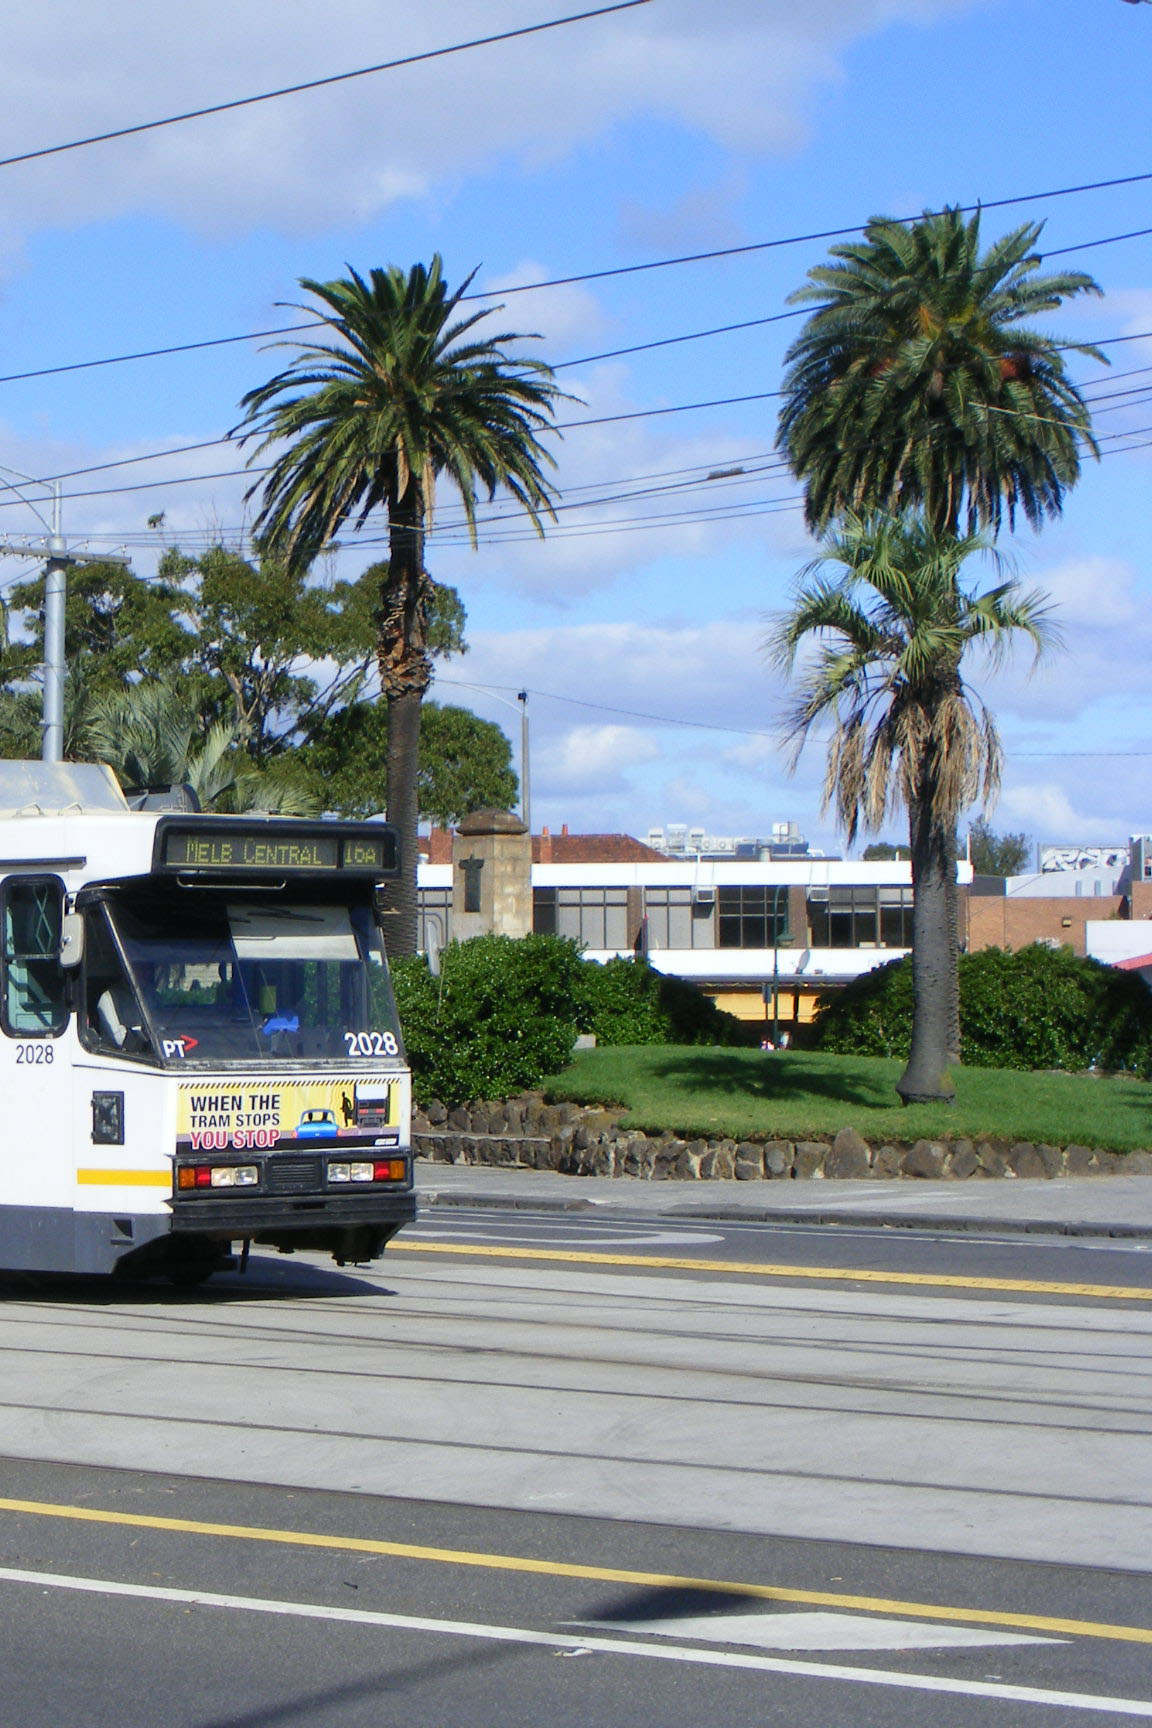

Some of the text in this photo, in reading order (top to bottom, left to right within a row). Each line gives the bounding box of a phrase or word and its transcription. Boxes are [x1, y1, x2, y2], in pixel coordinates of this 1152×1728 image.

[186, 841, 233, 863] MELB
[344, 1031, 398, 1056] 2028
[16, 1044, 54, 1064] 2028
[191, 1094, 280, 1112] WHEN THE
[190, 1113, 280, 1128] TRAM STOPS
[190, 1129, 281, 1149] YOU STOP
